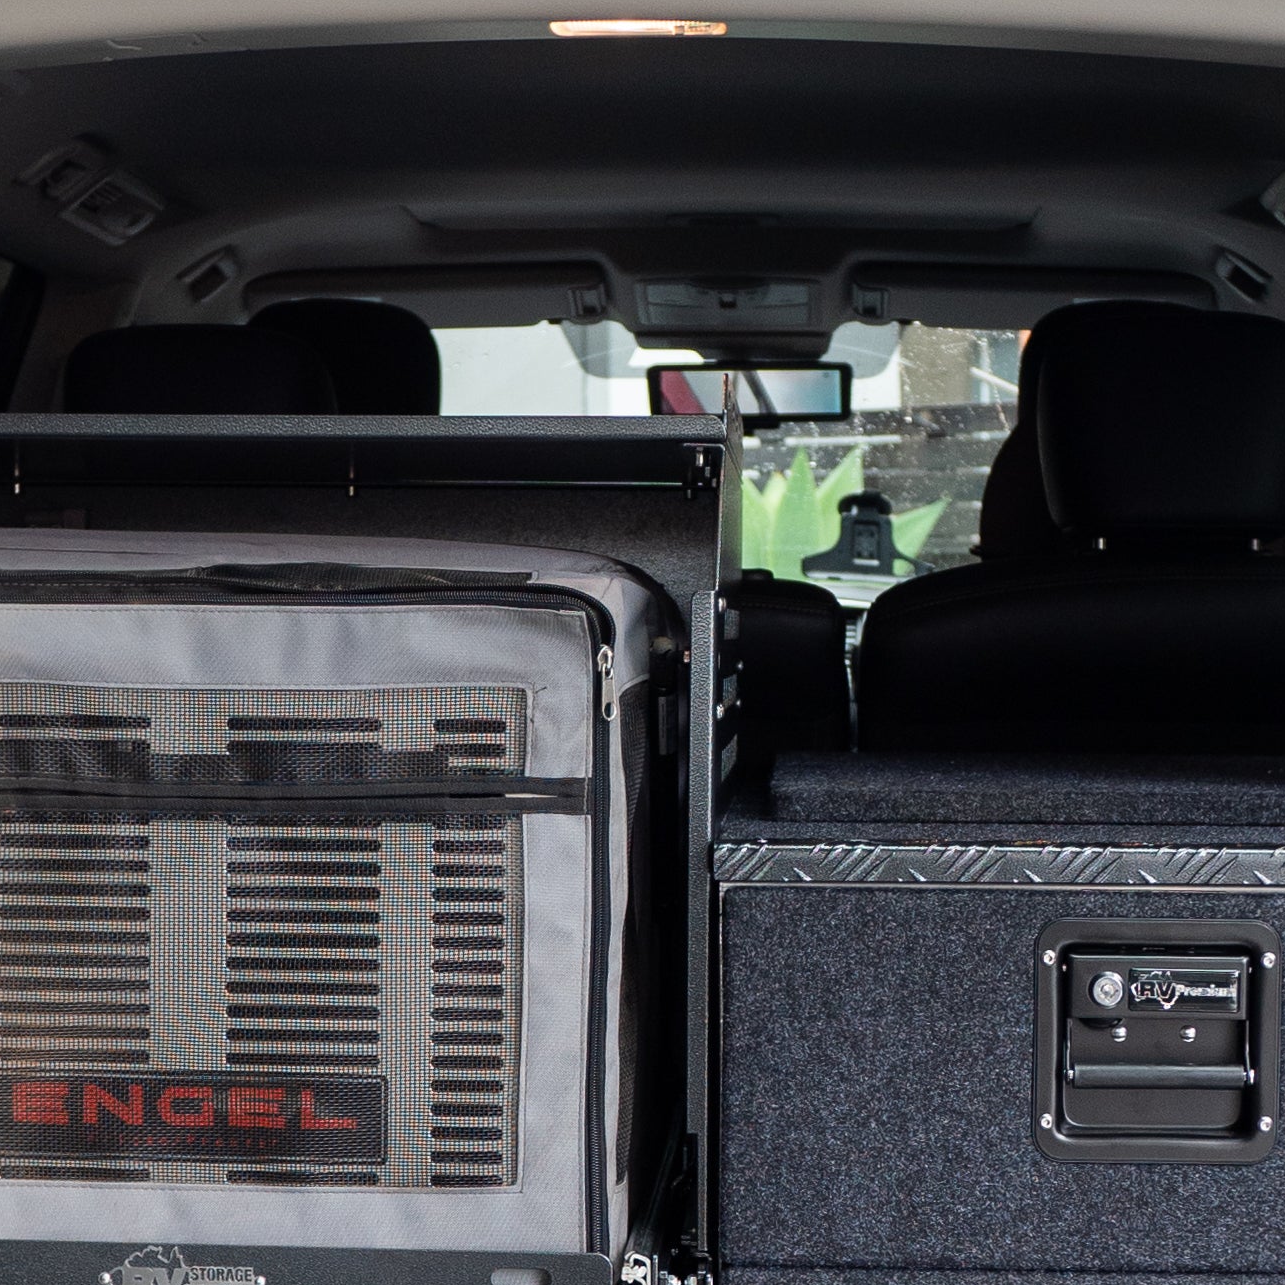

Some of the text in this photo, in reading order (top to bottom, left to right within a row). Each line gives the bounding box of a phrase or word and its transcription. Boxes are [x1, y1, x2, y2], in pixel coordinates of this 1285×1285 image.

[1138, 980, 1176, 998] RV
[12, 1081, 358, 1130] ENGEL
[190, 1267, 253, 1282] STORAGE
